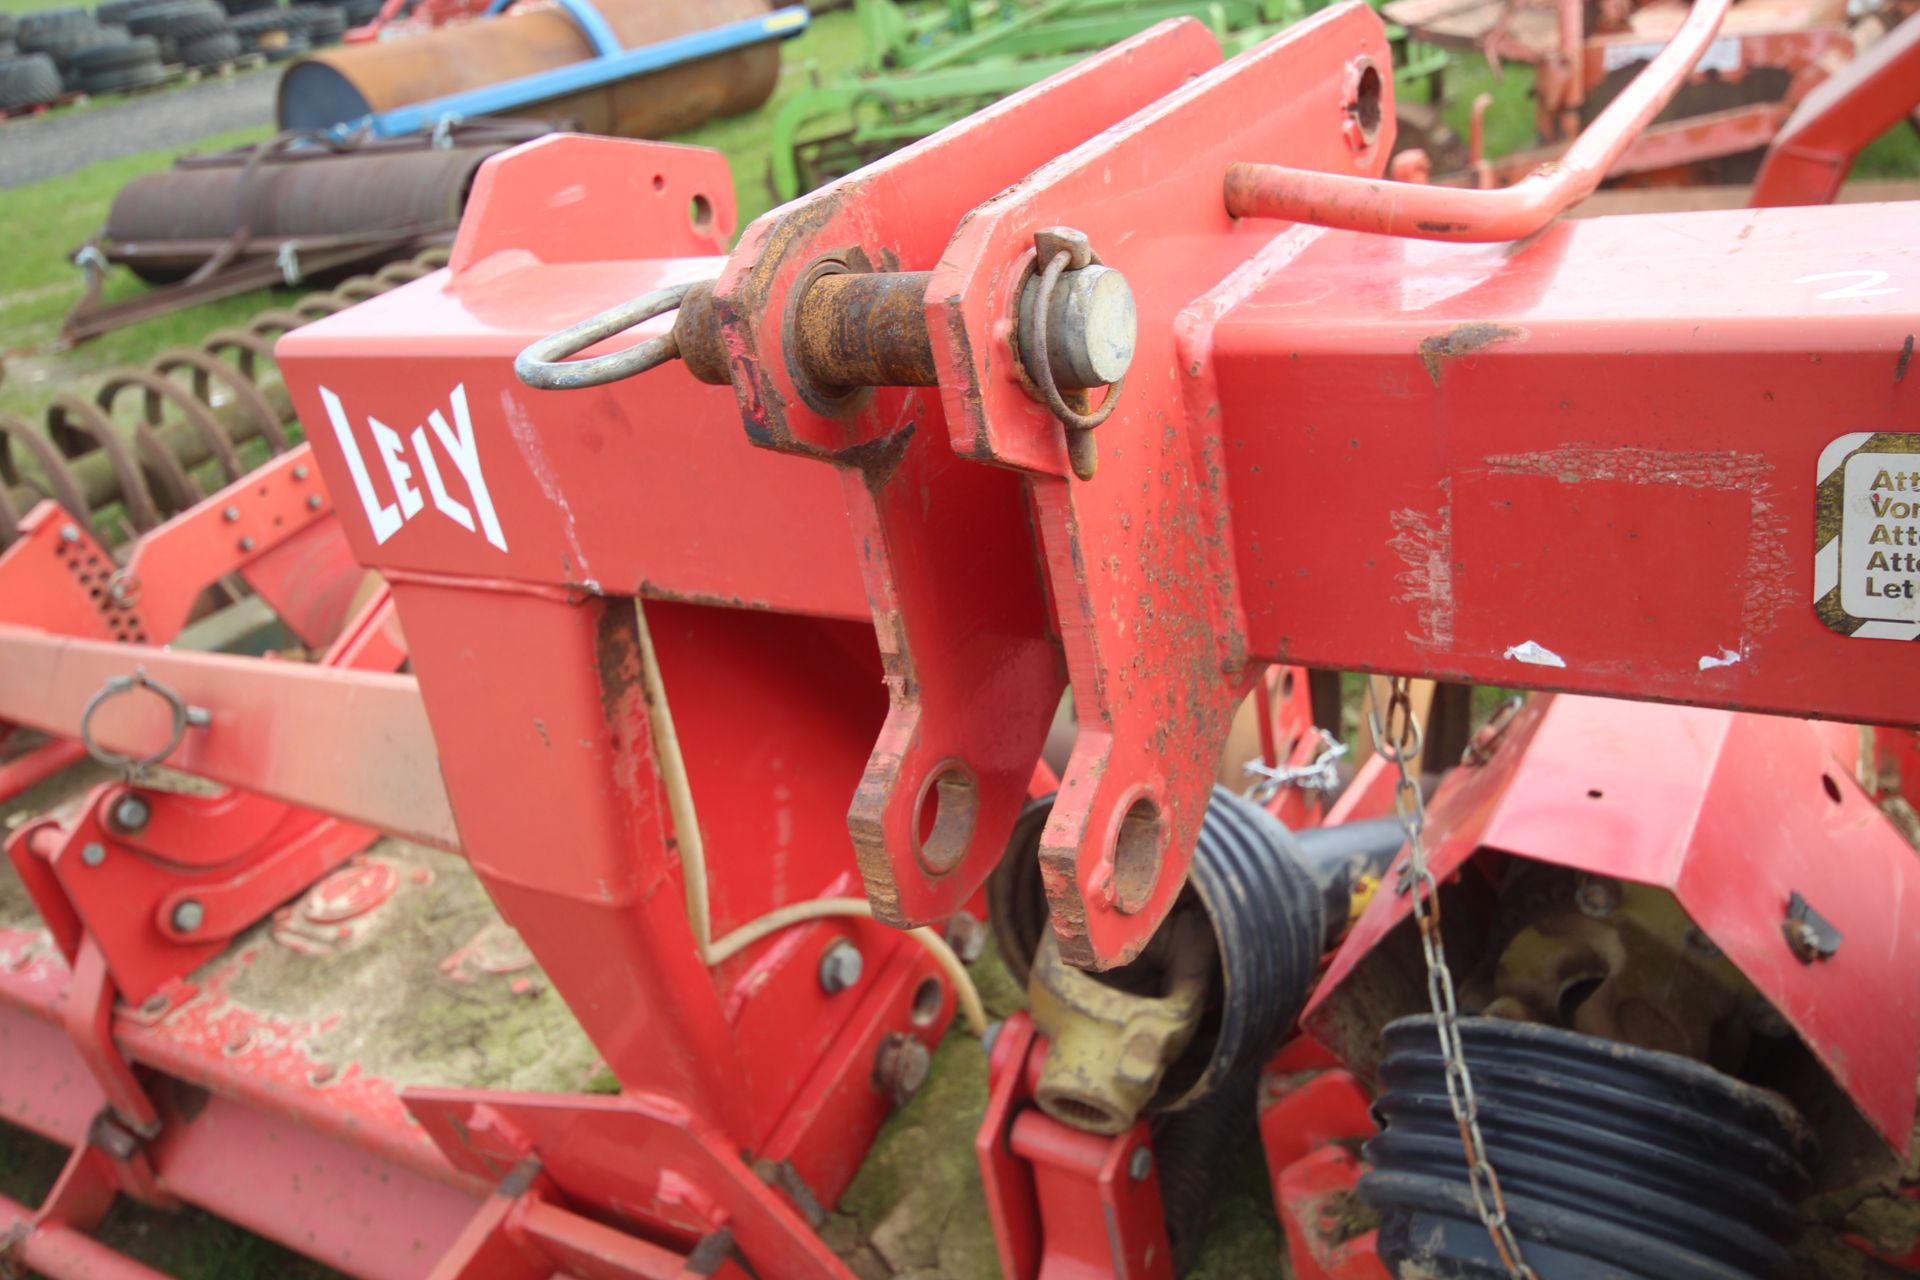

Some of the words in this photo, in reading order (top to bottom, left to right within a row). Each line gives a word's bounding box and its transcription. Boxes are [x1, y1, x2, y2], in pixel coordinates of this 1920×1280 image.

[318, 382, 508, 553] LELY
[1868, 524, 1920, 546] Att
[1866, 551, 1920, 573] Att
[1866, 577, 1914, 599] Let
